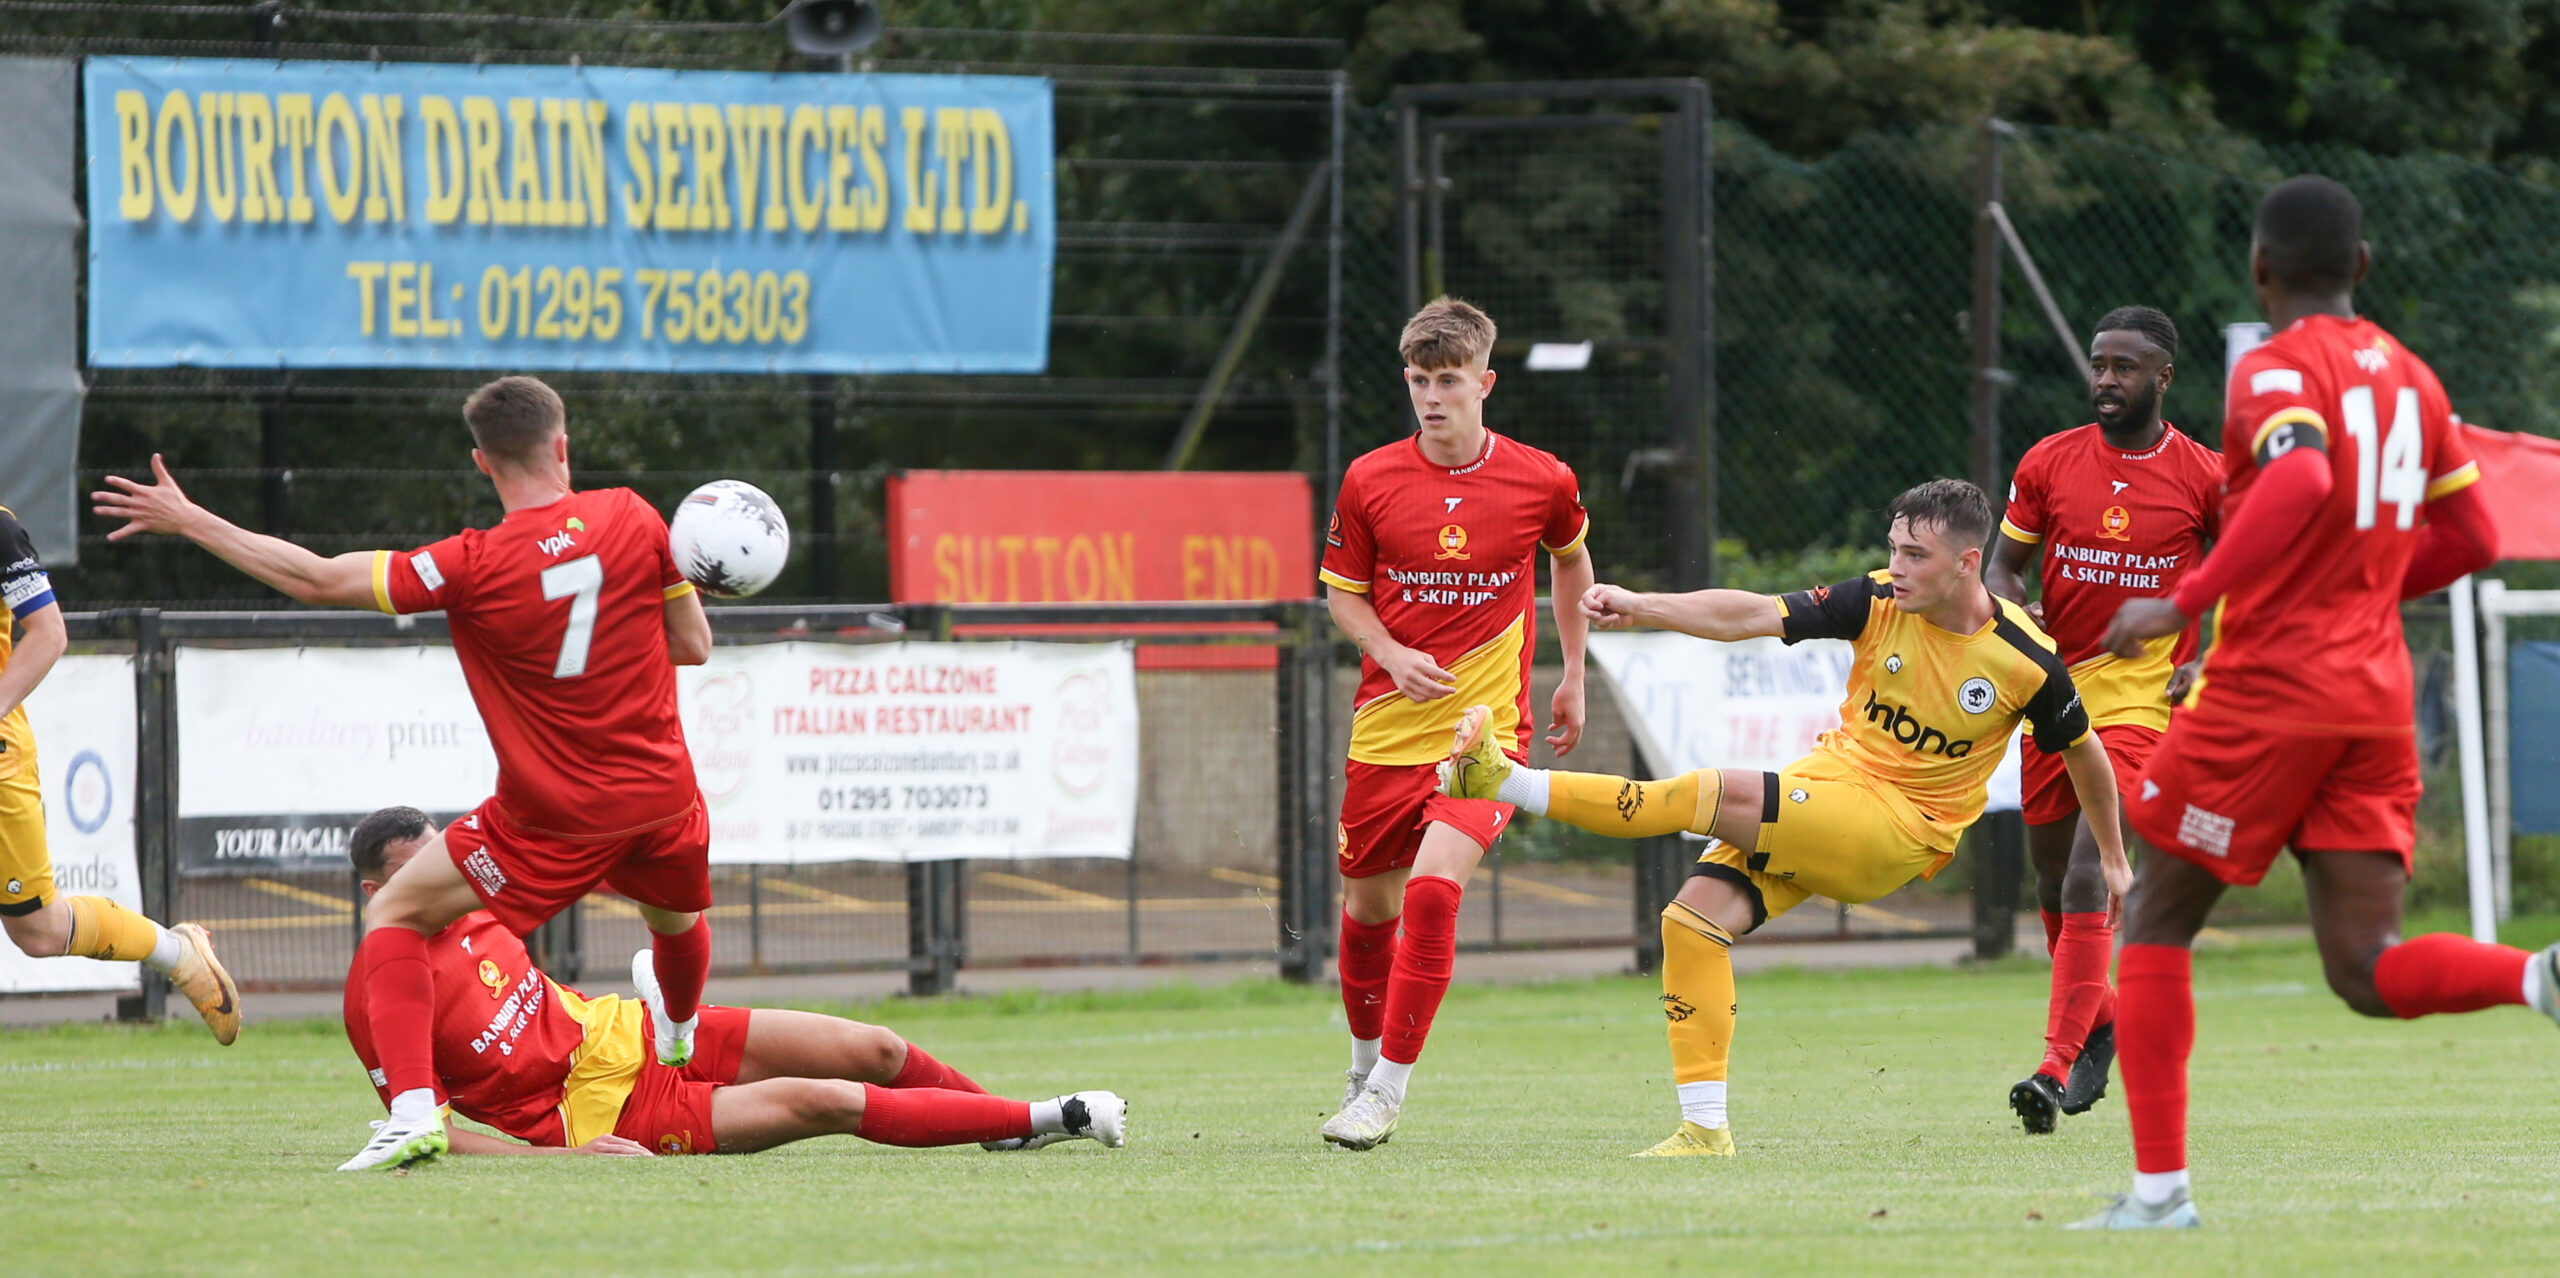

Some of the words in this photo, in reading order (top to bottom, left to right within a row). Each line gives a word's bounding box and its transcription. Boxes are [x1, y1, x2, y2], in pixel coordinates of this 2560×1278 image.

[115, 88, 404, 223] BOURTON
[419, 95, 607, 228] DRAIN
[623, 102, 889, 233] SERVICES
[902, 106, 1028, 235] LTD.
[346, 261, 464, 338] TEL:
[478, 264, 623, 342] 01295
[635, 268, 810, 344] 758303
[2267, 423, 2296, 459] C
[1449, 458, 1485, 476] BANBURY
[2341, 384, 2428, 531] 14
[536, 529, 576, 557] vpk
[2055, 543, 2122, 567] ANBURY
[933, 532, 1135, 602] SUTTON
[1183, 534, 1280, 601] END
[1467, 571, 1518, 588] PLAN
[2061, 563, 2074, 580] &
[2077, 566, 2116, 585] SKIP
[2119, 572, 2160, 589] HIRE
[1402, 588, 1414, 603] &
[1418, 589, 1459, 606] SKIP
[540, 553, 604, 679] 7
[810, 667, 878, 695] PIZZA
[886, 665, 998, 695] CALZONE
[387, 708, 459, 759] print
[773, 707, 867, 735] ITALIAN
[876, 704, 1033, 735] RESTAURANT
[819, 786, 892, 810] 01295
[902, 784, 989, 808] 703073
[215, 828, 278, 859] YOUR
[279, 827, 346, 858] LOCAL
[479, 845, 506, 884] VOLVO
[470, 990, 522, 1054] BANBURY
[499, 1041, 513, 1056] &
